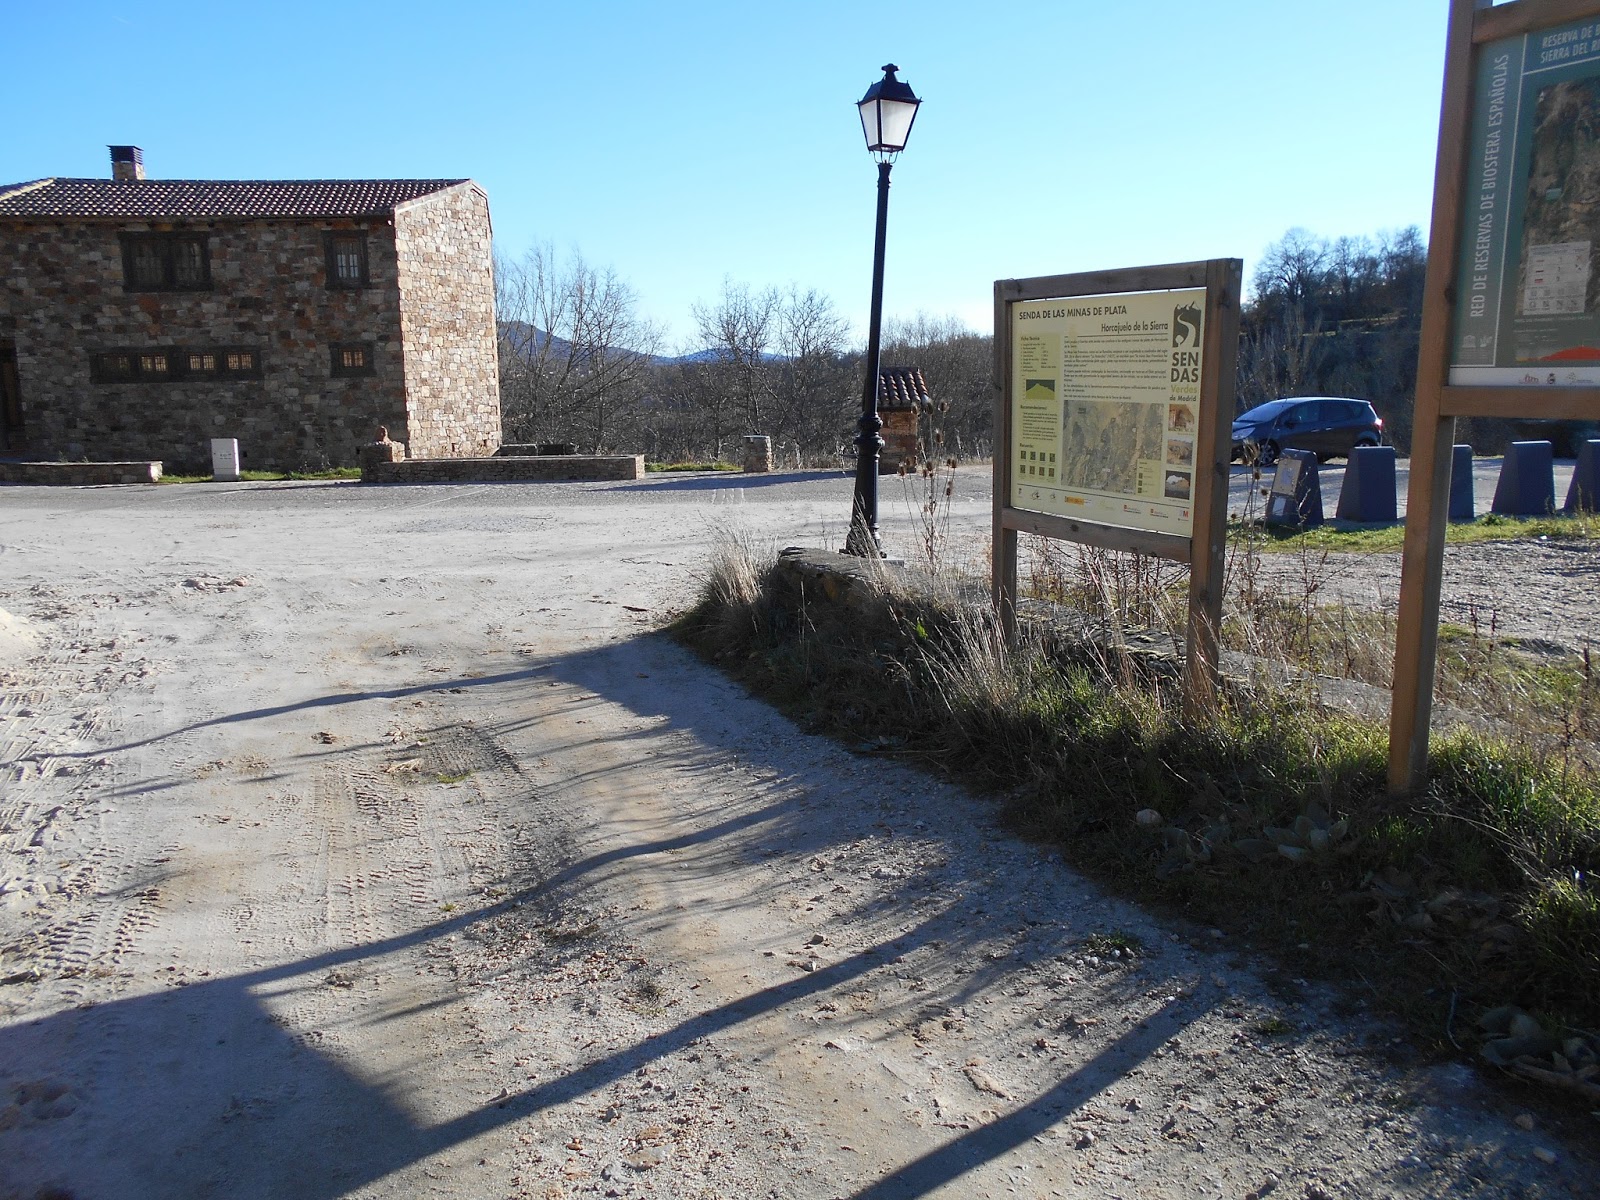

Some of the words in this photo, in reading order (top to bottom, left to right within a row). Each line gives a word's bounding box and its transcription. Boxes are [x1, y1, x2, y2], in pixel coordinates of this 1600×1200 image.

[1542, 30, 1578, 48] RESERVA
[1581, 25, 1594, 39] DE
[1541, 47, 1570, 64] SIERRA
[1573, 42, 1588, 56] DEL
[1488, 54, 1509, 127] ESPAÑOLAS
[1482, 130, 1501, 190] BIOSFERA
[1480, 194, 1494, 209] DE
[1474, 213, 1493, 271] RESERVAS
[1473, 274, 1487, 290] DE
[1019, 311, 1041, 320] SENDA
[1043, 310, 1051, 319] DE
[1053, 309, 1065, 318] LAS
[1067, 307, 1091, 317] MINAS
[1093, 307, 1102, 316] DE
[1104, 305, 1127, 315] PLATA
[1470, 294, 1486, 317] RED
[1101, 322, 1132, 334] Horcajuelo
[1133, 321, 1141, 331] de
[1142, 321, 1149, 331] la
[1150, 320, 1168, 331] Sierra
[1171, 351, 1199, 367] SEN
[1170, 367, 1199, 383] DAS
[1170, 384, 1198, 394] Verdes
